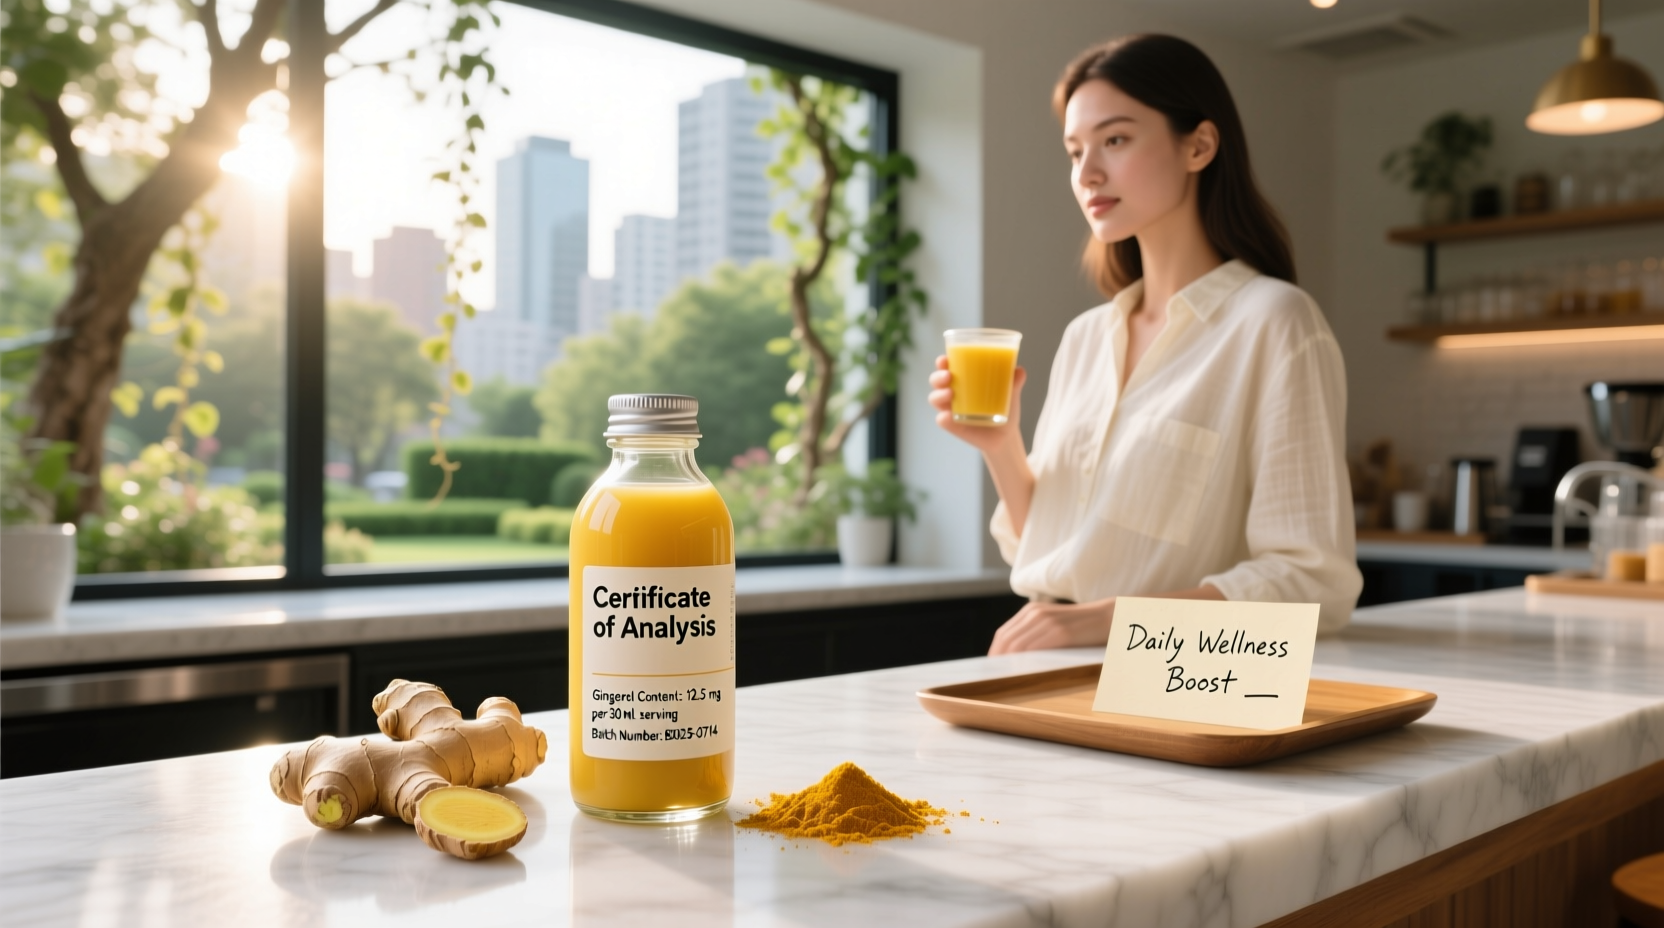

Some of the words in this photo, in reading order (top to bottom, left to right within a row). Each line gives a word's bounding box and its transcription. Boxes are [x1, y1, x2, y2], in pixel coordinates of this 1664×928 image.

[592, 614, 616, 638] of
[620, 613, 716, 645] Analysis
[1126, 623, 1184, 664] Daily
[1198, 628, 1289, 658] Wellness
[1165, 665, 1238, 694] Boost
[637, 690, 685, 703] Content:
[708, 690, 722, 703] mg
[591, 710, 608, 723] per
[609, 707, 622, 720] 30
[619, 729, 664, 742] Number:
